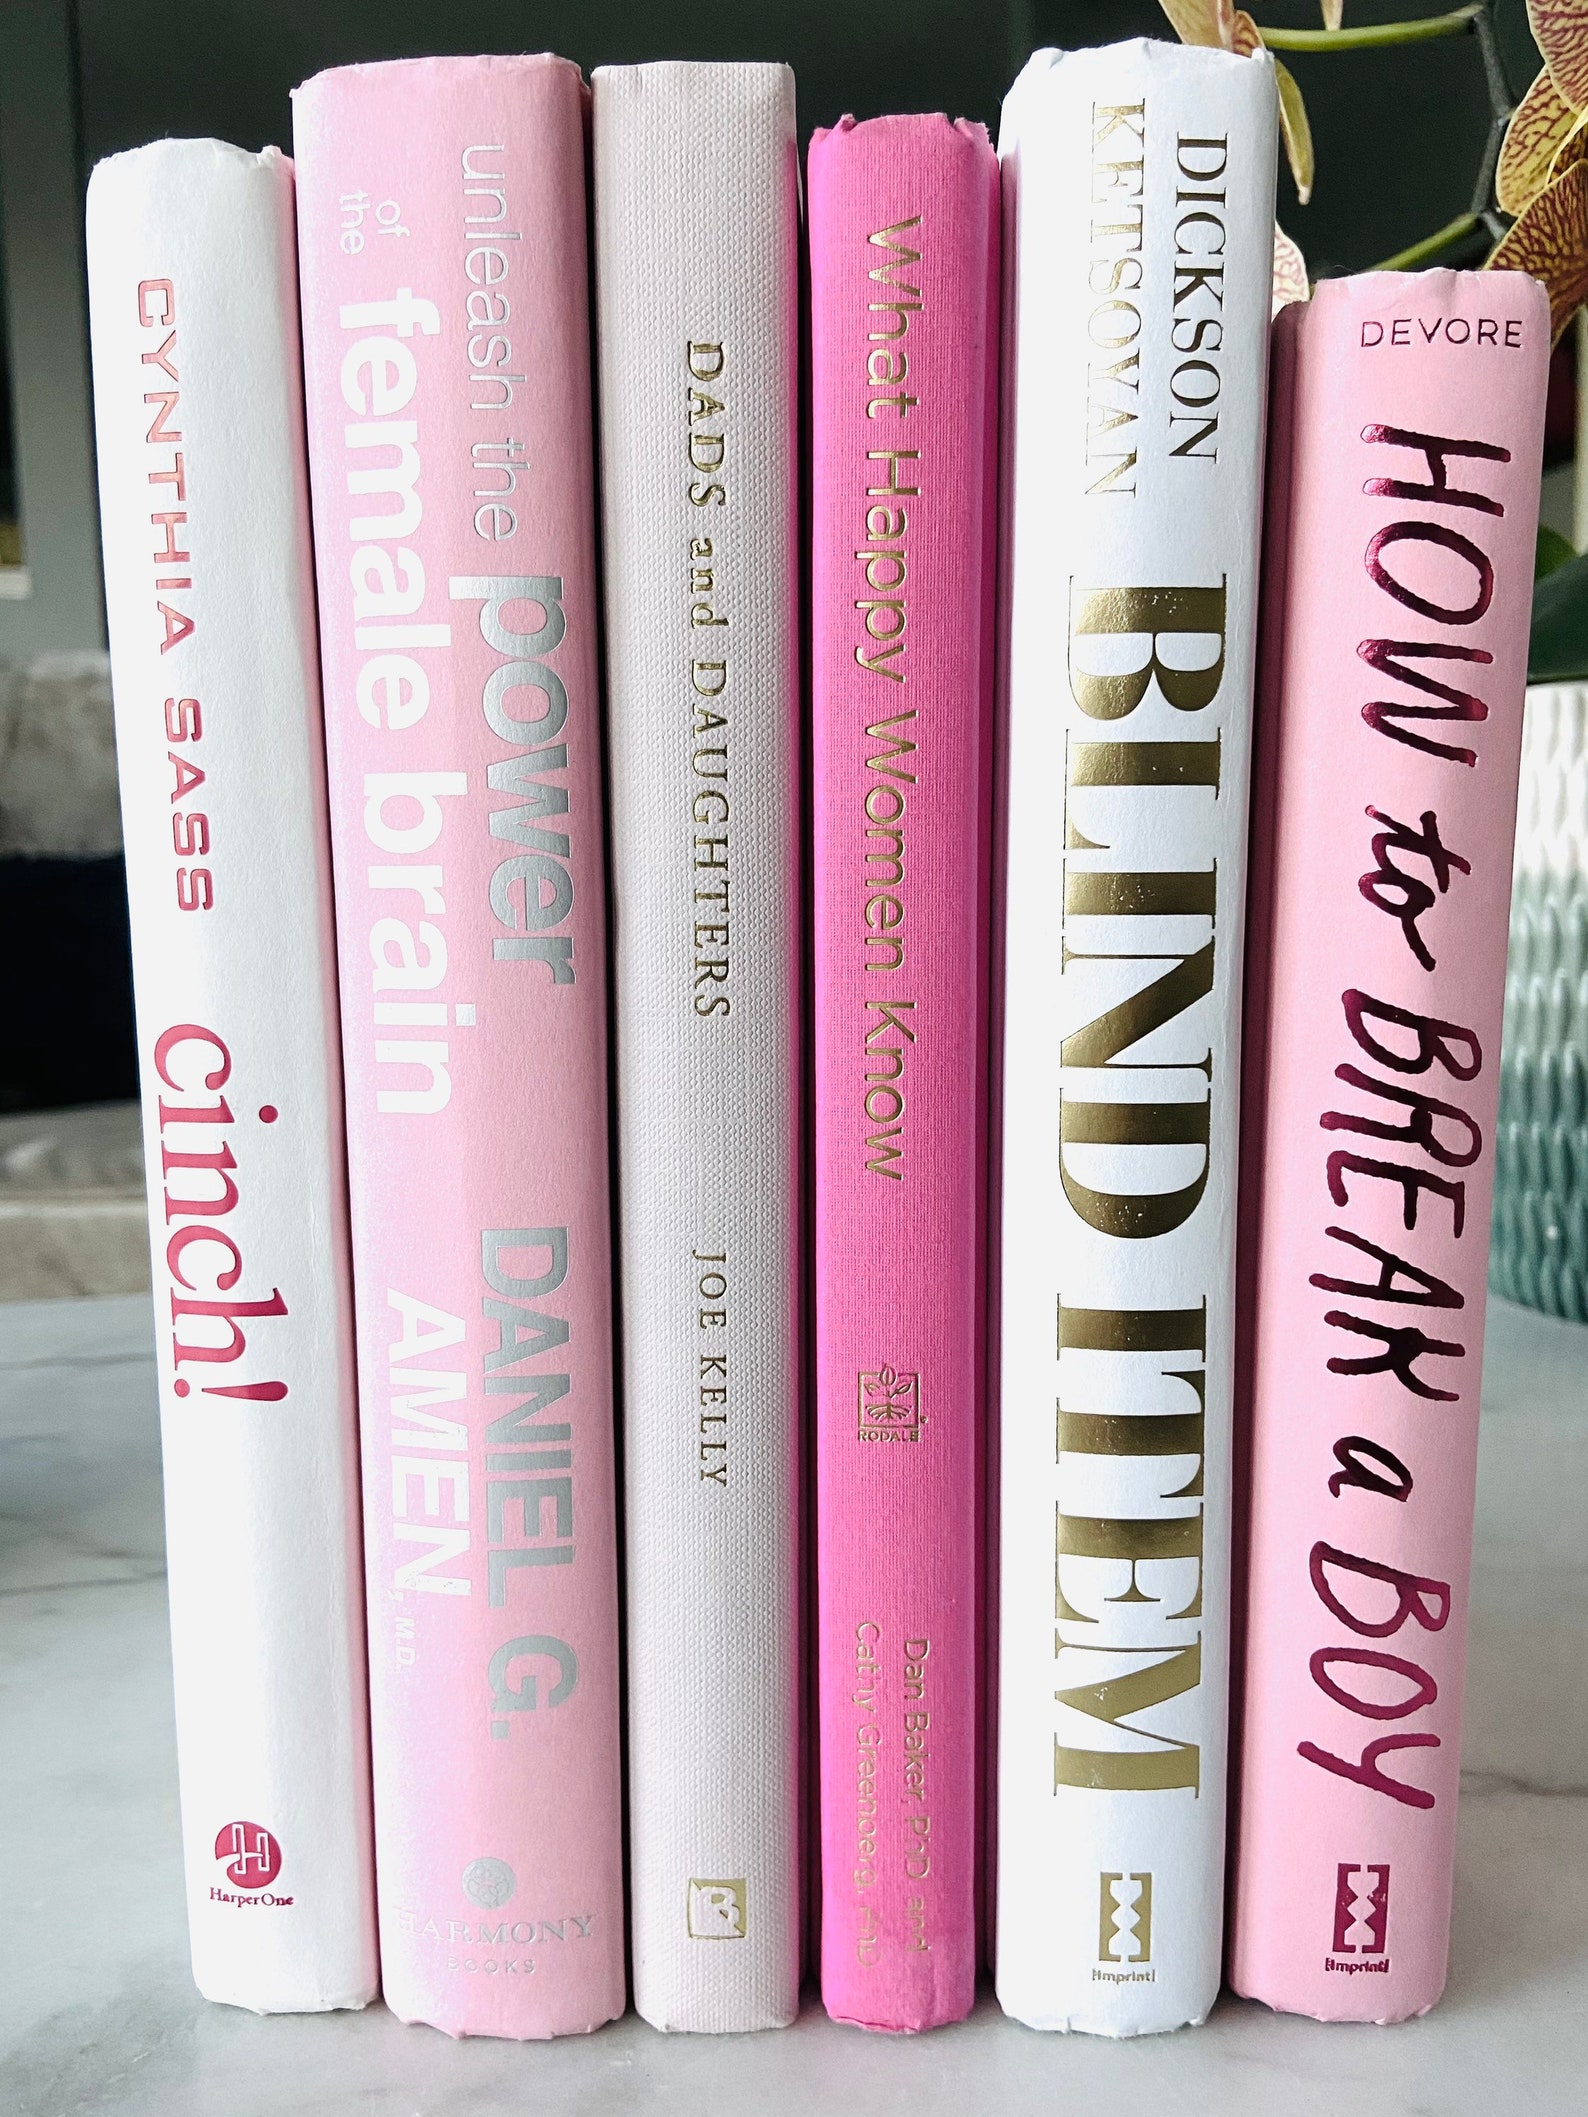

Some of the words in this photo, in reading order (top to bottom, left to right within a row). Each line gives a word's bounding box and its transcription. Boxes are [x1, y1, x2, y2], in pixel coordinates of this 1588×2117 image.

[339, 190, 371, 255] the
[376, 199, 410, 237] of
[461, 144, 526, 411] unleash
[1085, 98, 1145, 498] KETSOYAN
[1168, 130, 1229, 463] DICKSON
[867, 216, 923, 420] What
[1361, 317, 1525, 349] DEVORE
[138, 279, 195, 655] CYNTHIA
[339, 287, 453, 731] female
[471, 437, 531, 543] the
[687, 340, 727, 507] DADS
[690, 538, 731, 629] and
[855, 450, 922, 684] Happy
[1356, 423, 1511, 768] HOW
[164, 696, 213, 911] SASS
[449, 575, 577, 986] power
[691, 659, 732, 1018] DAUGHTERS
[864, 710, 919, 971] Women
[362, 771, 477, 1114] brain
[1059, 573, 1228, 1239] BLIND
[1358, 804, 1472, 972] to
[864, 1001, 917, 1181] Know
[154, 1023, 289, 1402] cinch!
[1310, 987, 1483, 1402] BREAK
[692, 1249, 728, 1330] JOE
[480, 1226, 577, 1608] DANIEL
[700, 1353, 728, 1488] KELLY
[858, 1430, 920, 1442] RODALE
[1328, 1434, 1412, 1503] a
[1054, 1293, 1206, 1799] ITEM
[488, 1634, 579, 1740] G.
[852, 1621, 881, 1713] Cathy
[905, 1639, 930, 1700] Dan
[1297, 1541, 1451, 1810] BOY
[209, 1887, 294, 1907] HarperOne
[394, 1911, 598, 1945] HARMONY
[905, 1816, 932, 1879] PhD
[906, 1897, 932, 1952] and
[447, 1956, 536, 1975] BOOKS
